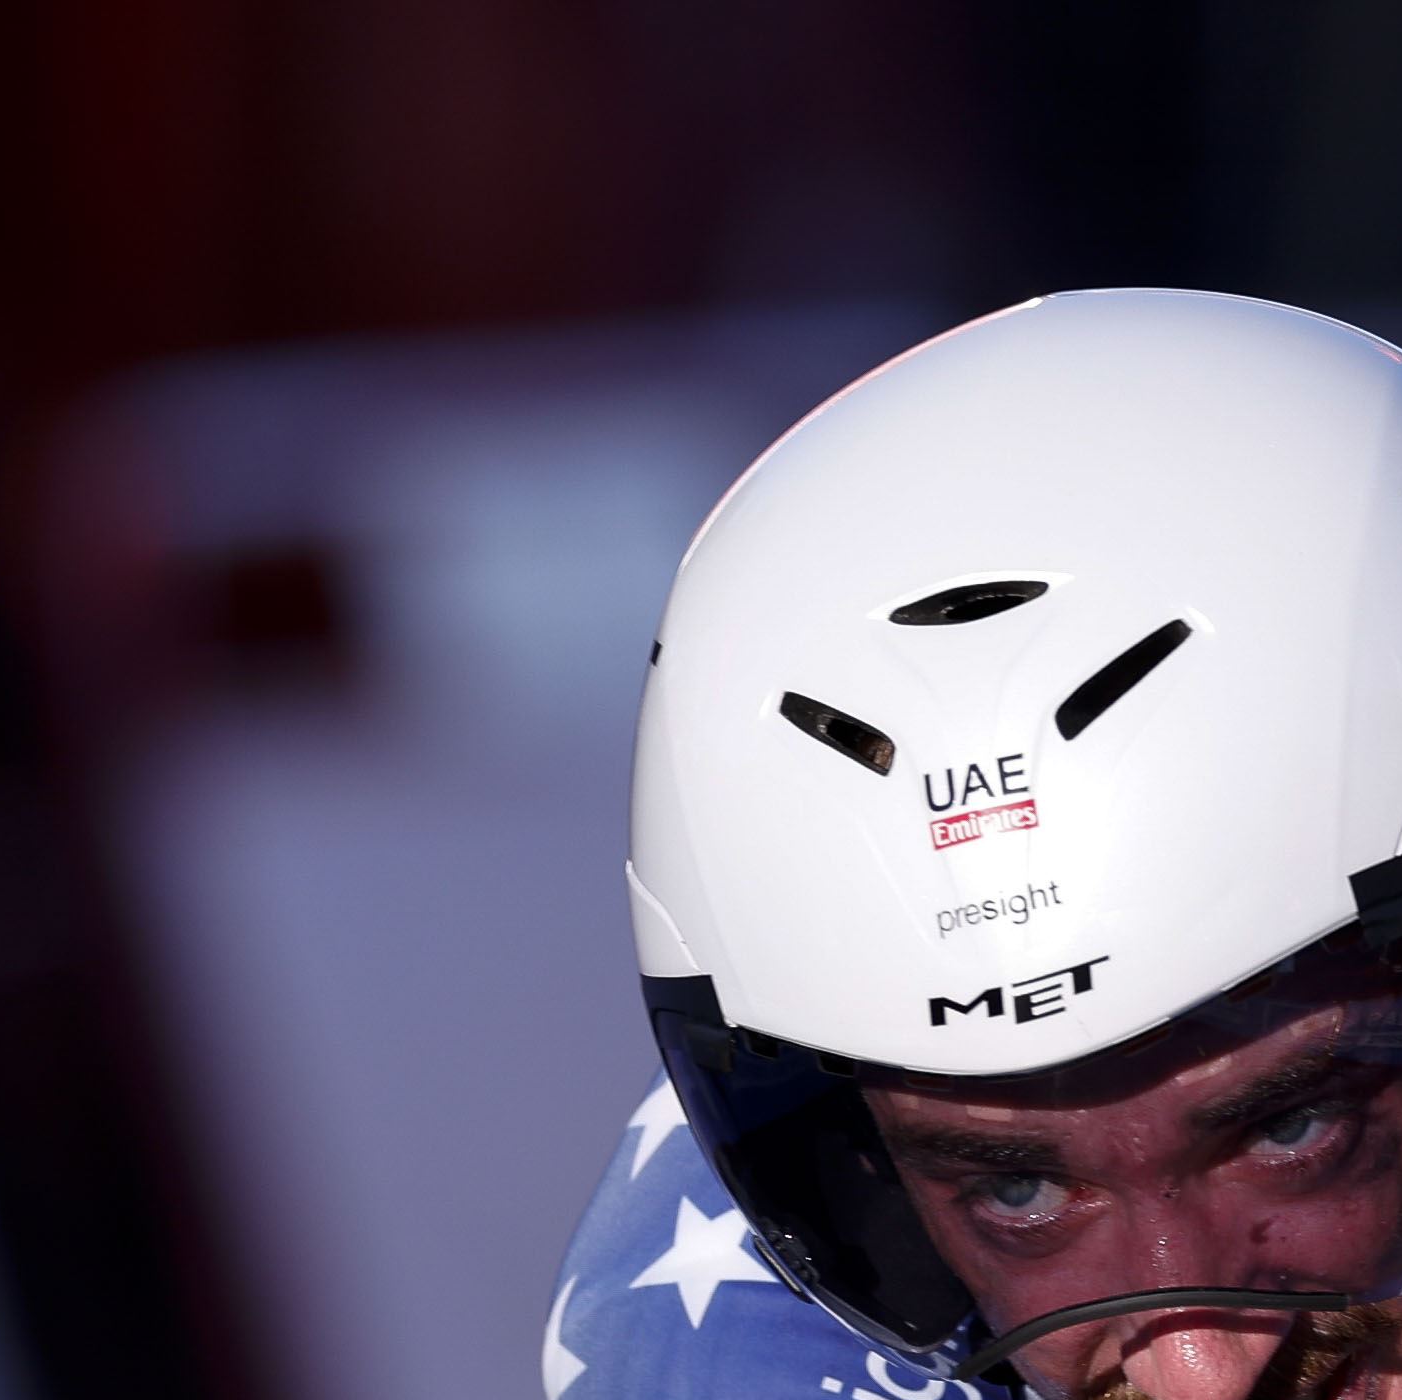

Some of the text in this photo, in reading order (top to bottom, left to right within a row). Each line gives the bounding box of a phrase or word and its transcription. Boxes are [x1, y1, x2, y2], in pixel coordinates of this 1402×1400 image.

[924, 753, 1030, 812] UAE
[936, 881, 1063, 939] presight
[928, 955, 1111, 1026] MET
